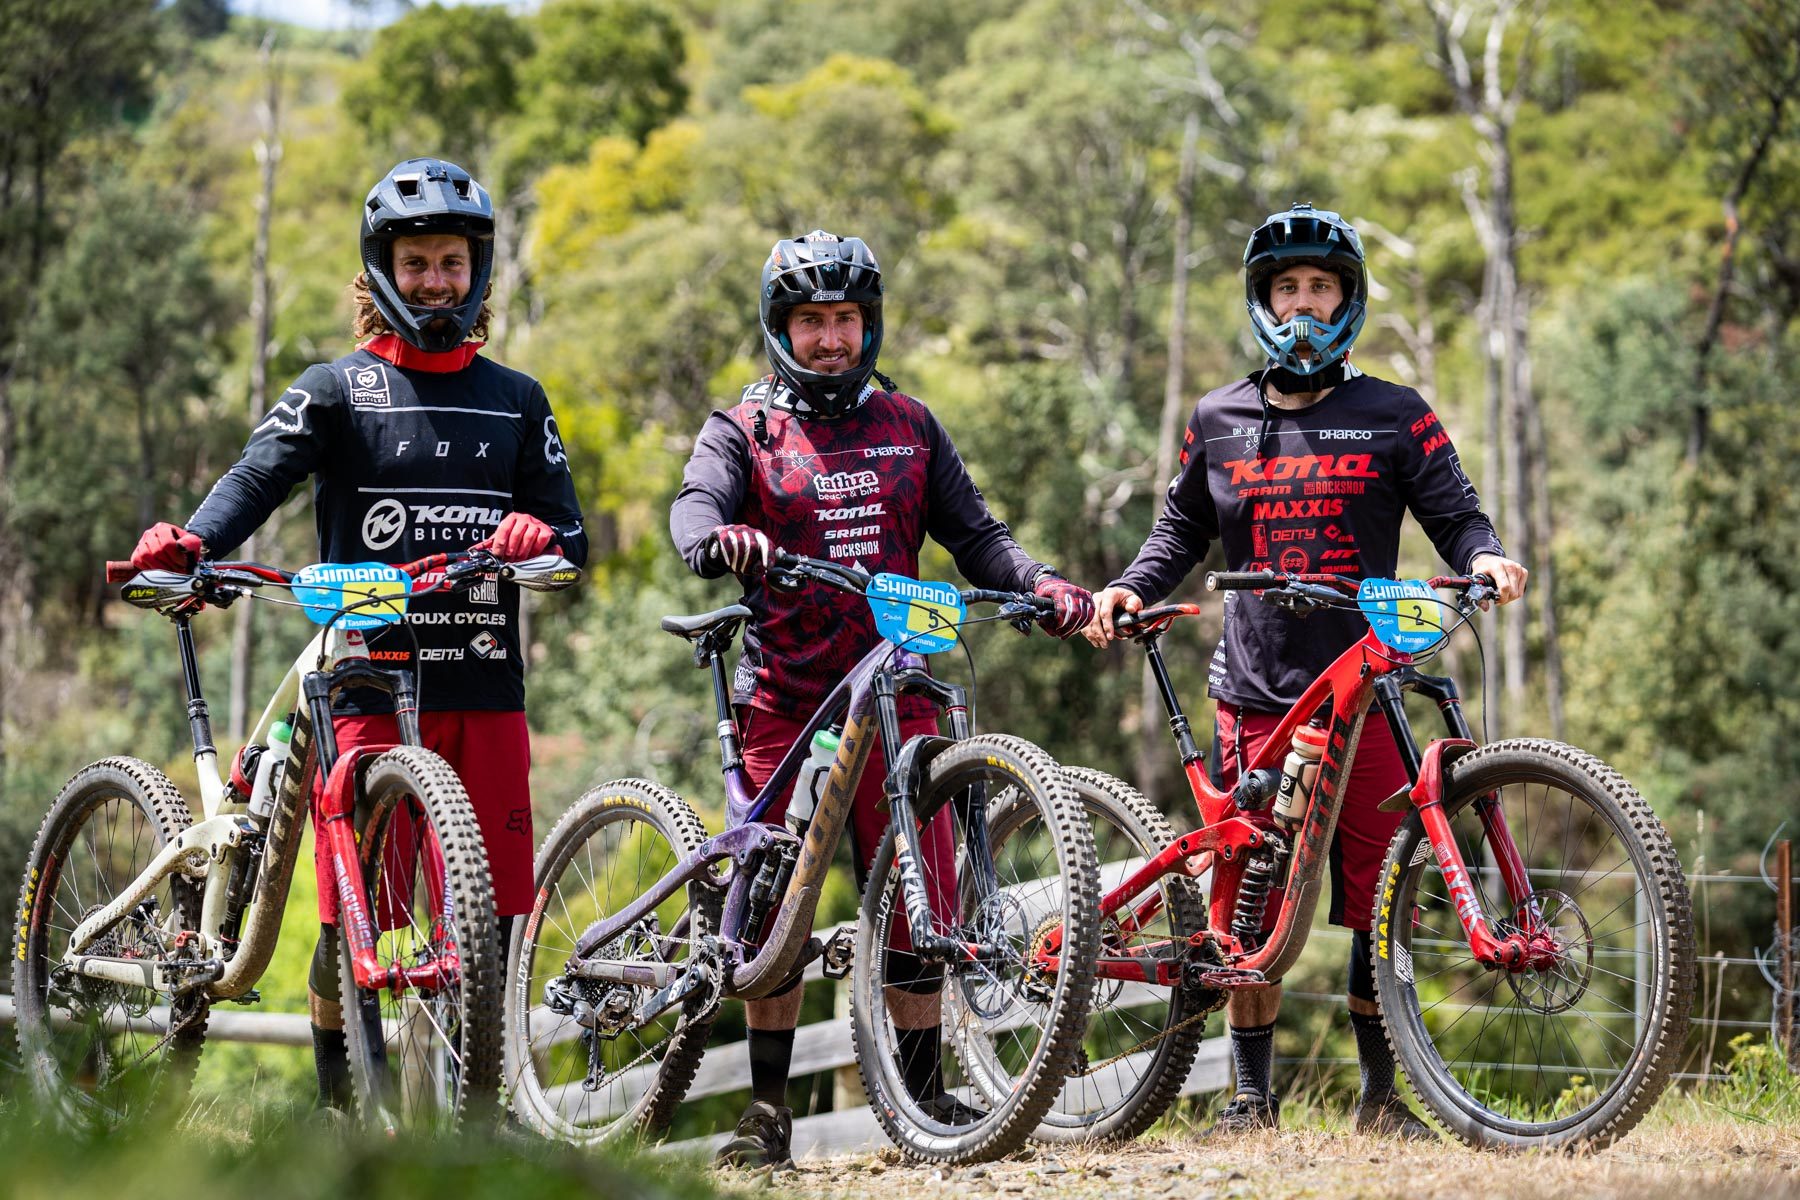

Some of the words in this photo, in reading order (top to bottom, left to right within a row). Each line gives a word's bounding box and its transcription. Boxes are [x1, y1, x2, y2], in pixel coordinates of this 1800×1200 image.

[395, 441, 491, 458] FOX
[814, 471, 879, 492] tathra
[1315, 480, 1365, 495] ROCKSHOX
[1237, 485, 1292, 499] SRAM
[1252, 498, 1344, 521] MAXXIS
[414, 528, 487, 541] BICYCL
[824, 525, 881, 540] SRAM
[1271, 528, 1317, 542] DEITY
[829, 541, 880, 559] ROCKSHOX
[298, 567, 398, 584] SHIMANO
[876, 579, 957, 606] SHIMANO
[1363, 585, 1432, 600] SHIMANO
[348, 619, 382, 627] Tasmania
[454, 612, 507, 626] CYCLES
[928, 607, 939, 629] 5
[1412, 605, 1425, 626] 2
[370, 650, 410, 661] MAXXIS
[419, 648, 465, 661] DEITY
[603, 795, 652, 813] MAXXIS
[17, 866, 39, 962] MAXXIS
[1378, 861, 1401, 960] MAXXIS
